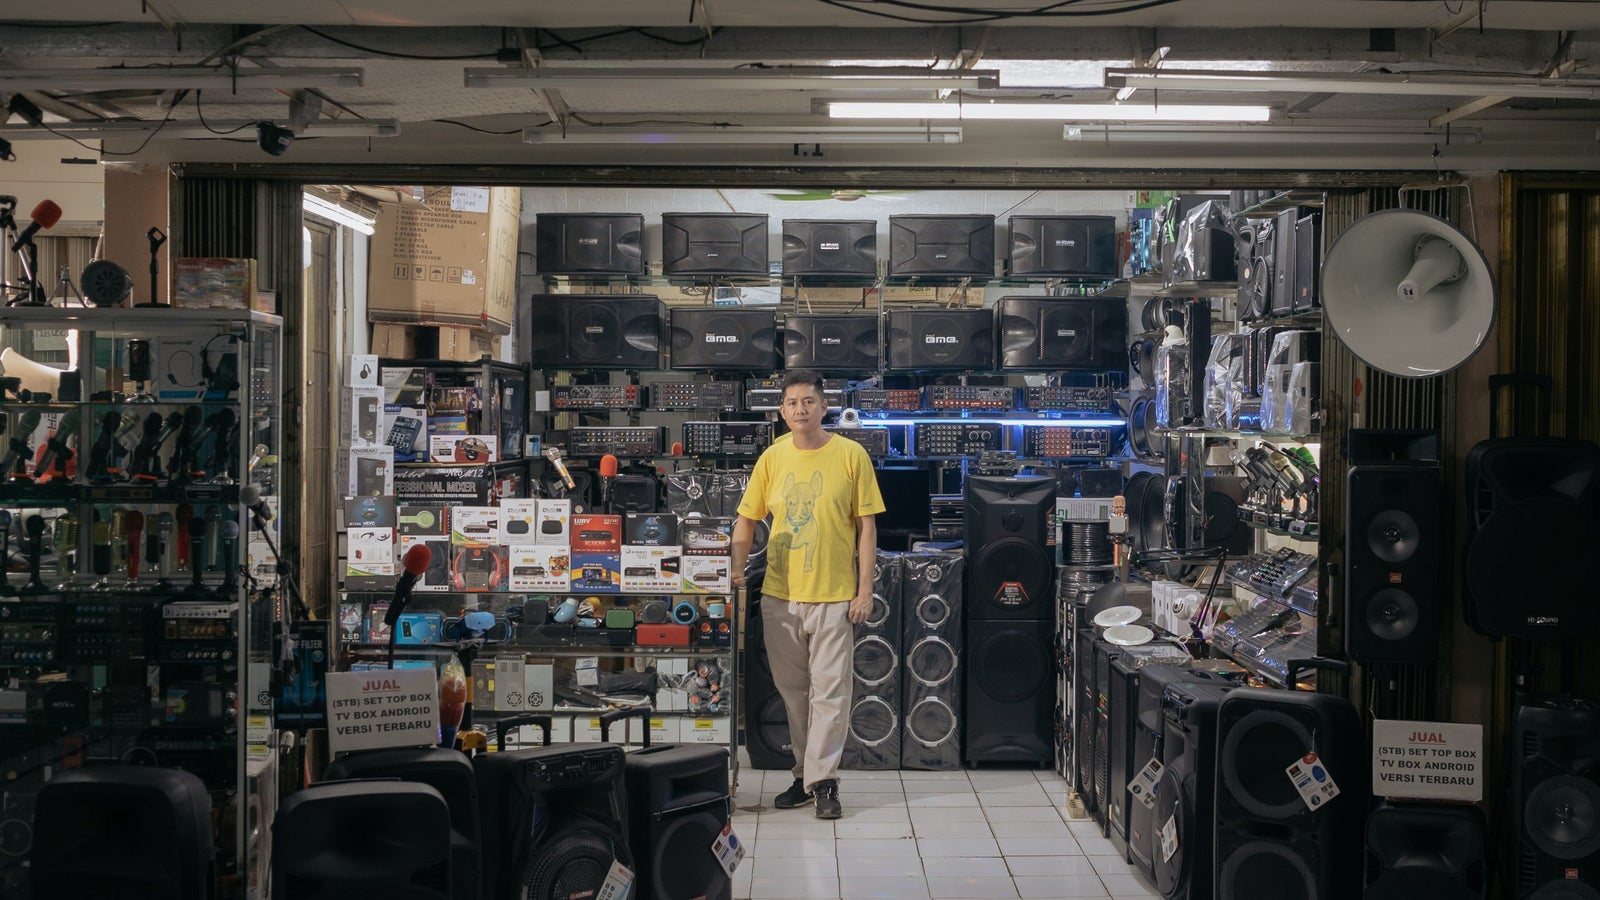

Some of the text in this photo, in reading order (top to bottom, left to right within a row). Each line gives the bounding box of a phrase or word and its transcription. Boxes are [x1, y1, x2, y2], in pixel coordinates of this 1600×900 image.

[446, 481, 476, 492] MIXER
[301, 639, 323, 649] FILTER
[362, 679, 400, 691] JUAL
[332, 693, 432, 709] (STB) SET TOP BOX
[335, 706, 431, 721] TV BOX ANDROID
[336, 720, 432, 736] VERSI TERBARU
[1408, 732, 1447, 743] JUAL
[1378, 746, 1477, 759] (STB) SET TOP BOX
[1380, 759, 1475, 771] TV BOX ANDROID
[1380, 773, 1475, 786] VERSI TERBARU
